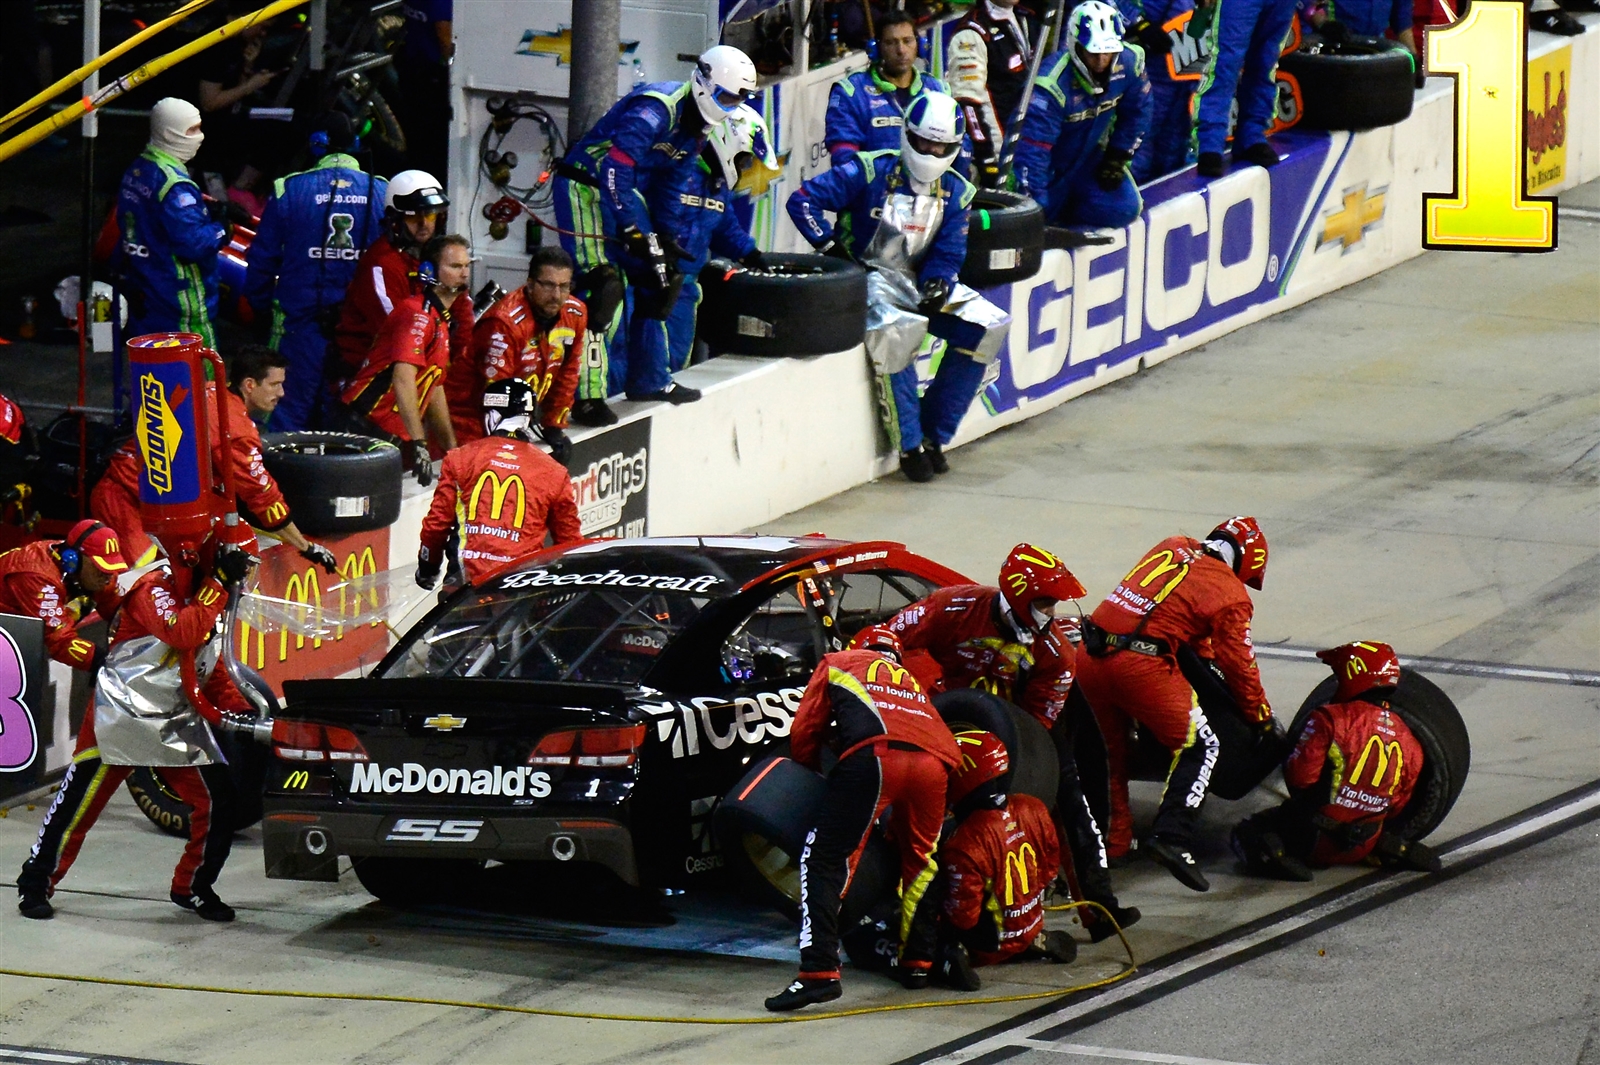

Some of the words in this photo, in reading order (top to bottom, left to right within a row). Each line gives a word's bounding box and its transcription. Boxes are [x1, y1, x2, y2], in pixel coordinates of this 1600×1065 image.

[1426, 1, 1553, 247] 1
[307, 247, 367, 261] GEIC
[1009, 166, 1272, 390] GEICO
[139, 374, 173, 491] SUNOCO
[480, 525, 512, 541] lovin'
[512, 530, 520, 543] it
[498, 569, 725, 593] Beechcraft
[886, 687, 916, 700] lovin'
[916, 692, 927, 703] it
[691, 686, 807, 750] Cess
[349, 762, 552, 798] McDonald's
[584, 778, 601, 798] 1
[1341, 786, 1357, 798] i'm
[385, 818, 485, 843] SS
